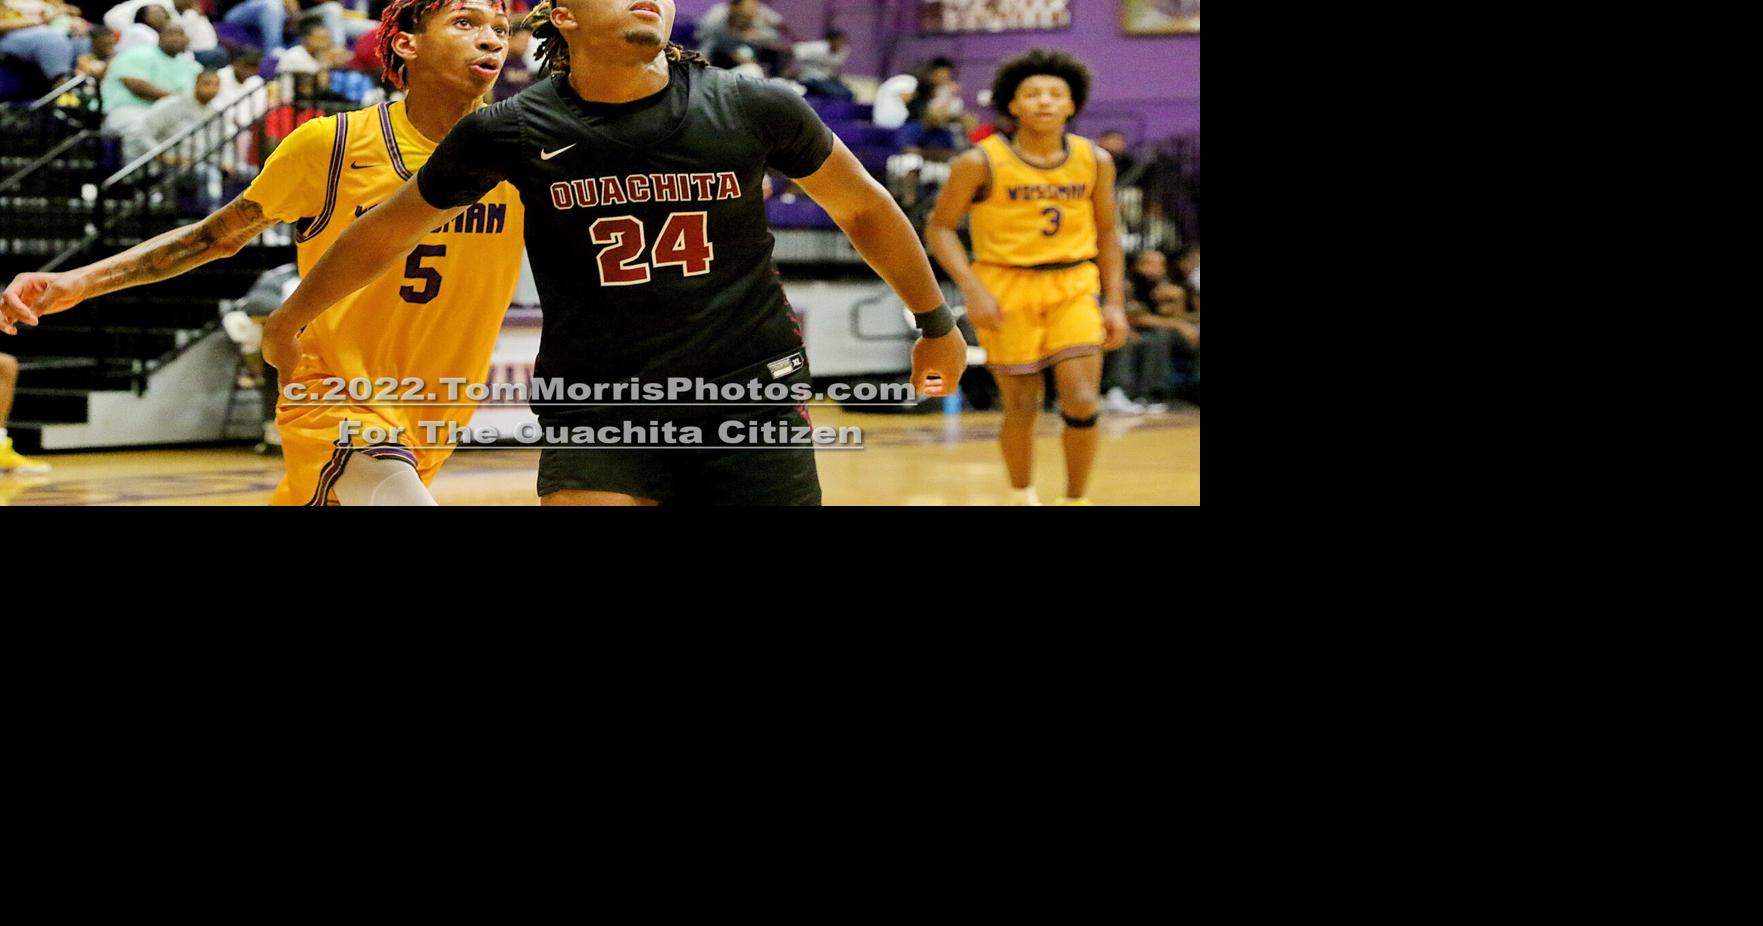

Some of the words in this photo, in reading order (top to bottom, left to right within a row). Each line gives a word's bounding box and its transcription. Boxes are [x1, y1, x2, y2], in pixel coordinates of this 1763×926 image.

[550, 171, 742, 210] OUACHITA
[1041, 207, 1061, 237] 3
[588, 210, 714, 287] 24
[399, 244, 447, 304] 5
